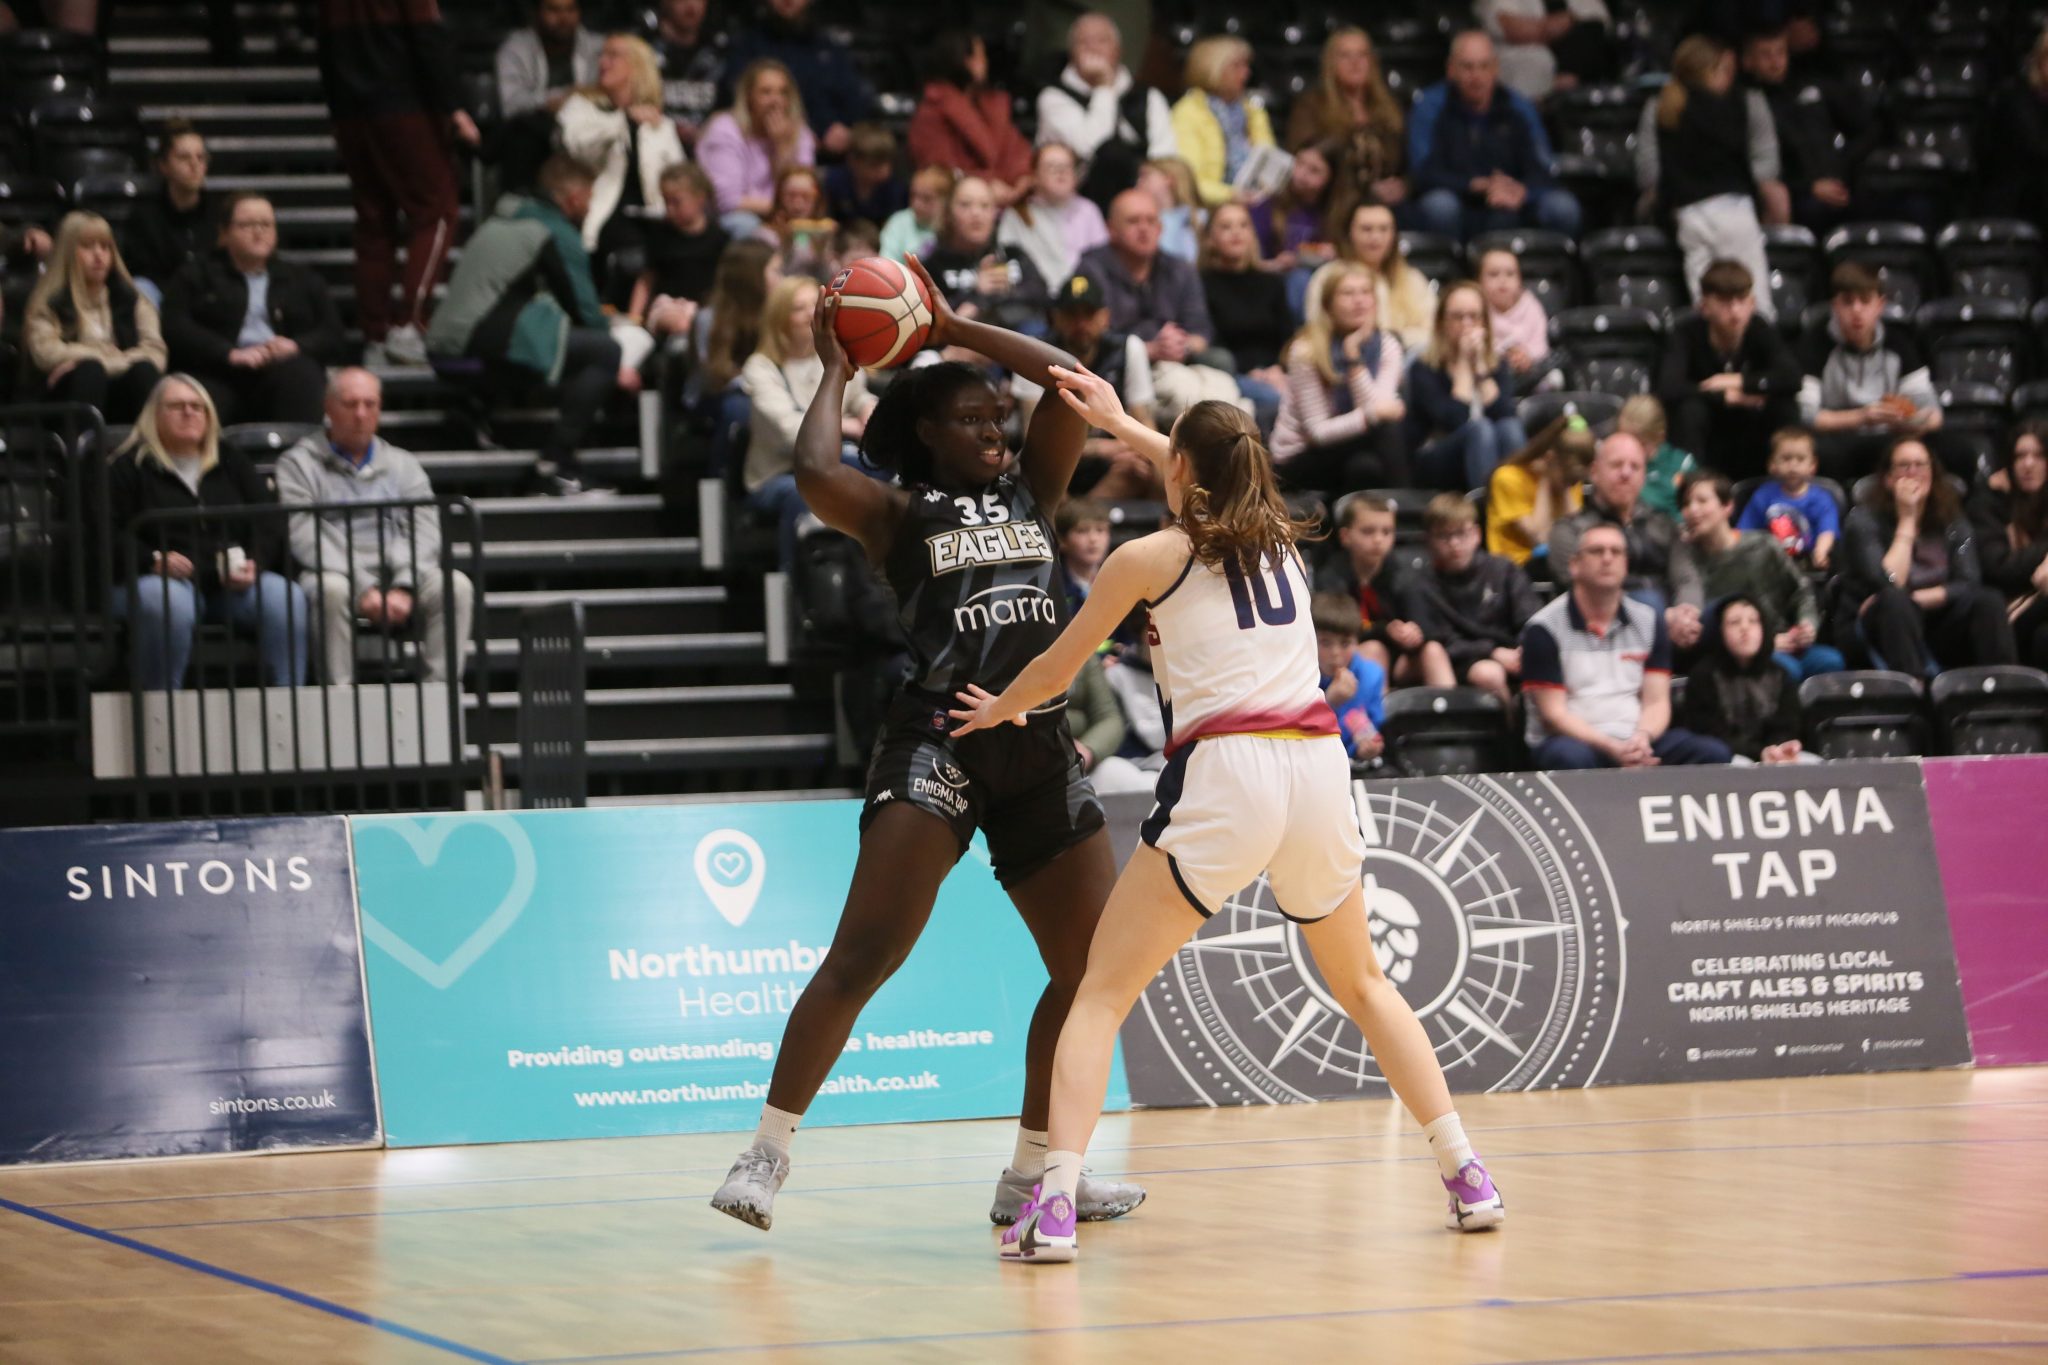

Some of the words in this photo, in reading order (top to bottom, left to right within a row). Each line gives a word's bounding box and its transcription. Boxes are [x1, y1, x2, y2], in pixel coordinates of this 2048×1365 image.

[954, 493, 1009, 526] 35
[926, 521, 1053, 577] EAGLES
[1222, 545, 1296, 630] 10
[954, 596, 1056, 632] marra
[913, 777, 954, 806] ENIGMA
[1639, 786, 1895, 844] ENIGMA
[65, 856, 313, 901] SINTONS
[1711, 848, 1838, 900] TAP
[1671, 919, 1721, 935] NORTH
[1786, 914, 1824, 930] FIRST
[1825, 911, 1899, 928] MICROPUB
[608, 940, 832, 981] Northumbr
[1691, 953, 1825, 977] CELEBRATING
[1828, 950, 1894, 970] LOCAL
[1667, 979, 1744, 1003] CRAFT
[1749, 976, 1807, 999] ALES
[1811, 975, 1830, 996] &
[1832, 971, 1925, 993] SPIRITS
[1689, 1004, 1748, 1023] NORTH
[1750, 1001, 1824, 1021] SHIELDS
[1826, 996, 1911, 1016] HERITAGE
[508, 1045, 625, 1068] Providing
[629, 1037, 773, 1063] outstanding
[866, 1029, 994, 1051] healthcare
[208, 1088, 336, 1116] sintons.co.uk
